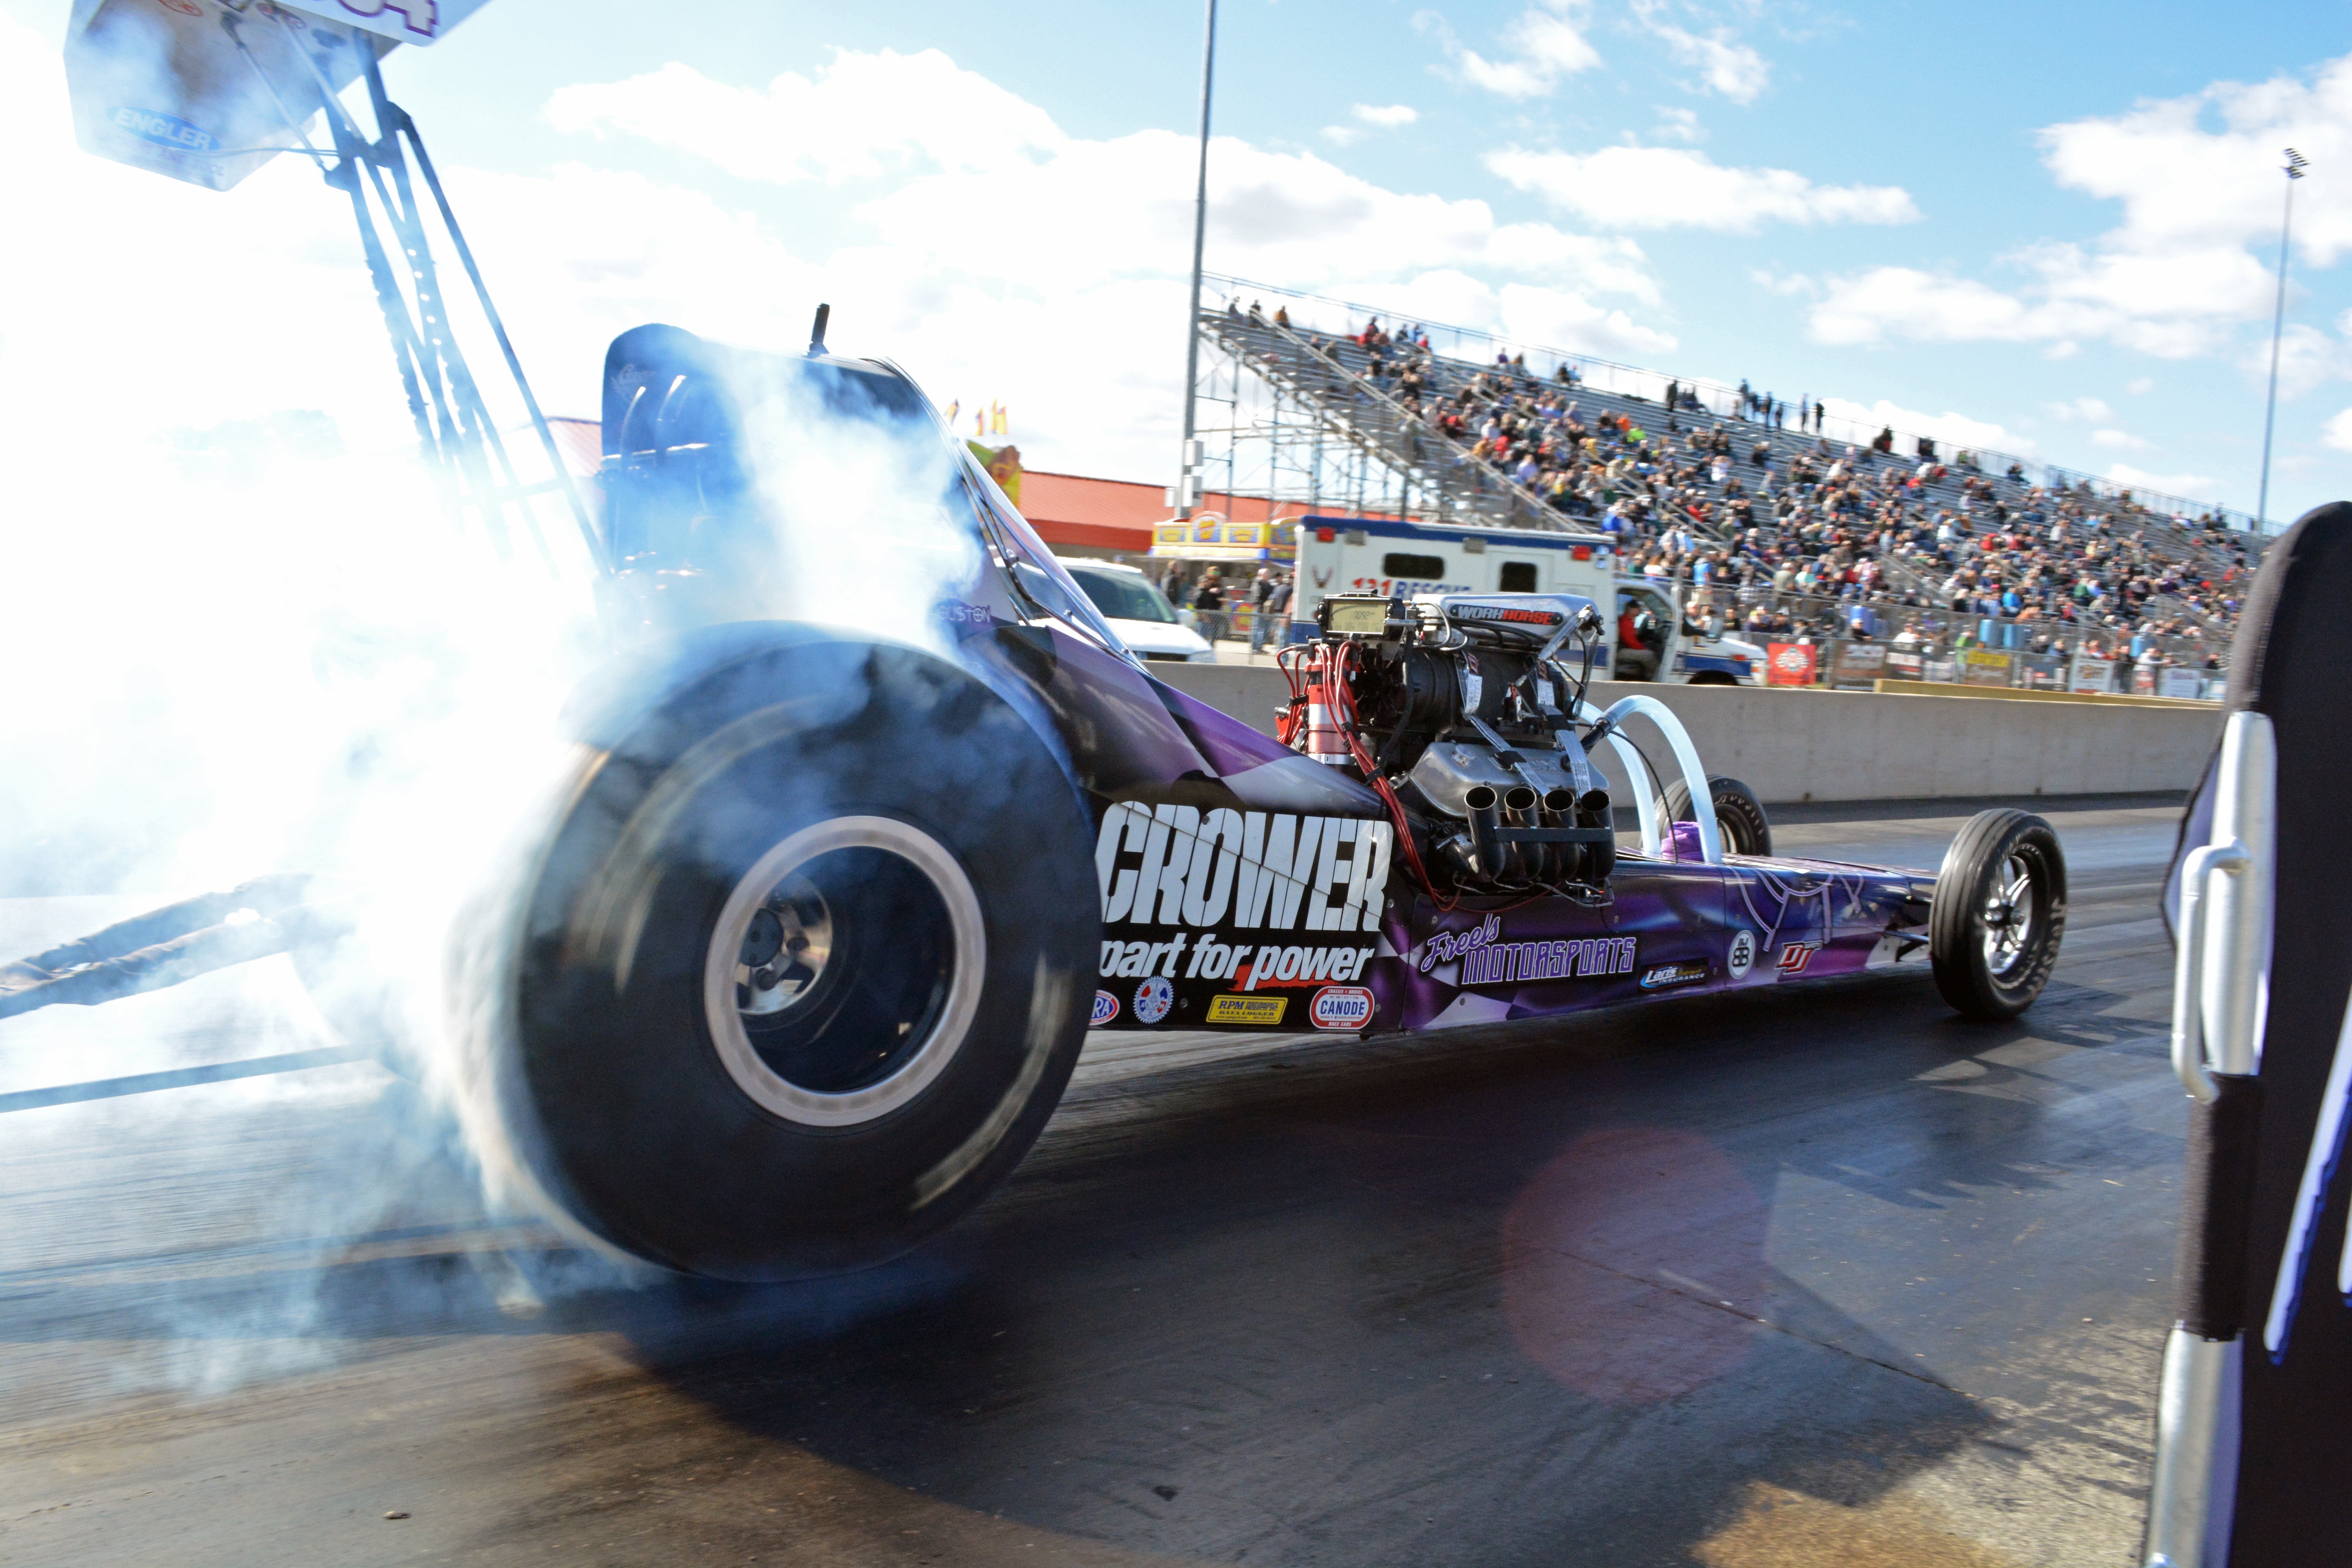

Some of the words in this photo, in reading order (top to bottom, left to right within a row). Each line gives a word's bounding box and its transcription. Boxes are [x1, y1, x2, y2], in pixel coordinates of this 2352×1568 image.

[114, 107, 212, 151] ENGLER
[1457, 606, 1555, 625] WORKHORSE
[1095, 801, 1393, 931] CROWER
[1185, 933, 1253, 980] for
[1244, 946, 1374, 991] power
[1421, 913, 1500, 972] Freels
[1462, 937, 1636, 985] MOTORSPORTS
[1659, 973, 1705, 983] INSURANCE
[1218, 1000, 1245, 1009] RPM
[1320, 1000, 1365, 1015] CANODE
